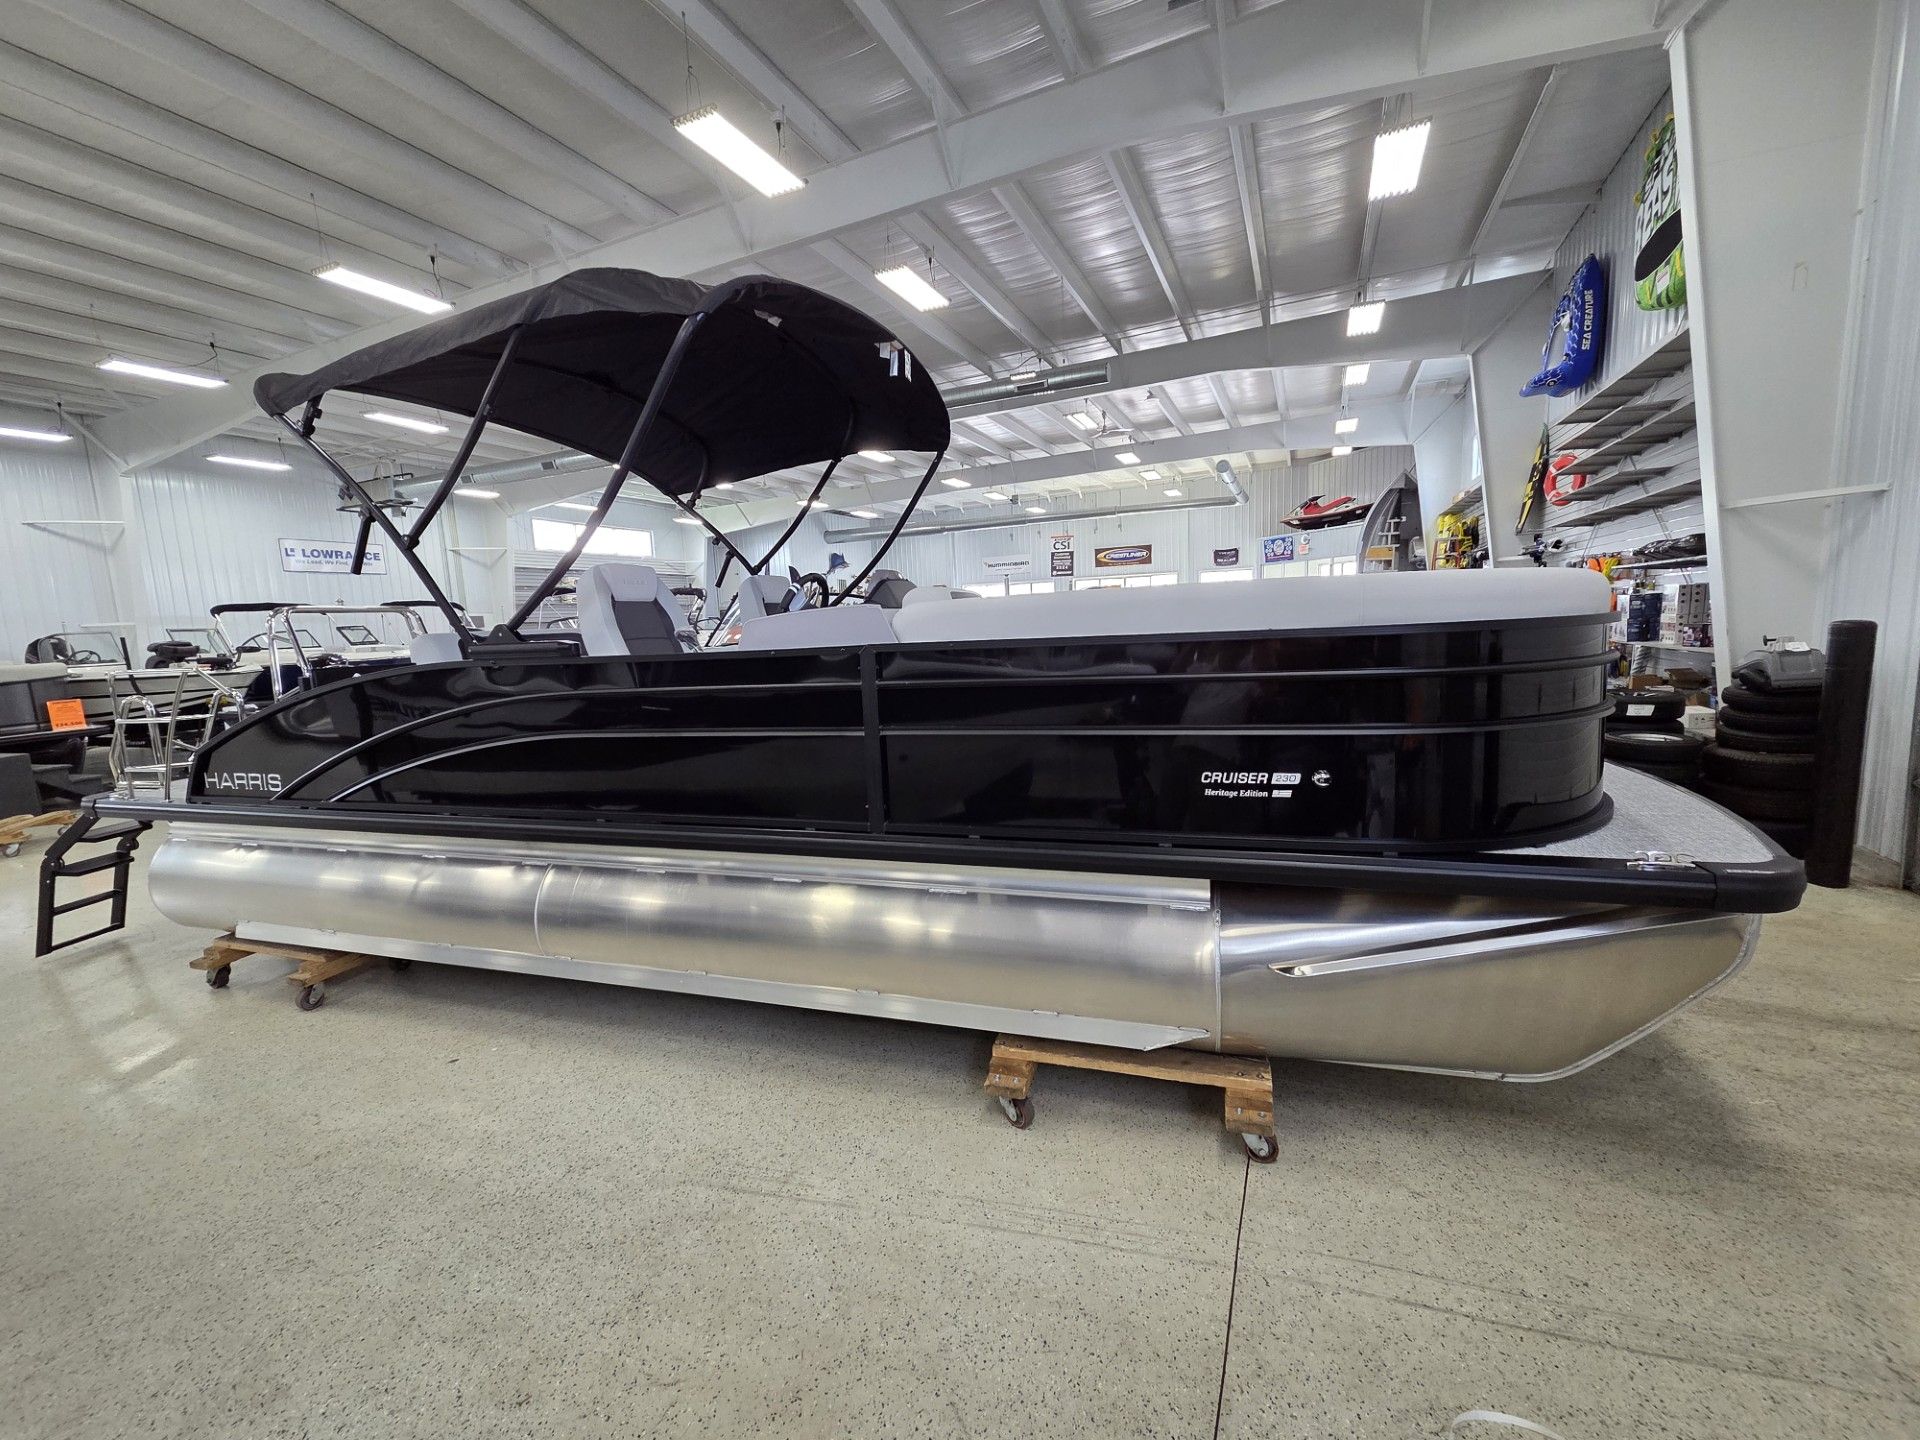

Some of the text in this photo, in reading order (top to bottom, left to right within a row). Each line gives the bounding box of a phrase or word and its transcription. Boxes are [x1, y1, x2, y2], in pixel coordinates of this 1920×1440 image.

[1582, 289, 1594, 350] SEA CREATURE
[1053, 540, 1070, 550] CSI
[301, 548, 381, 561] LOWRACE
[204, 772, 282, 792] HARRIS
[1201, 772, 1297, 784] CRUISER 230
[1204, 788, 1269, 799] Heritage Edition
